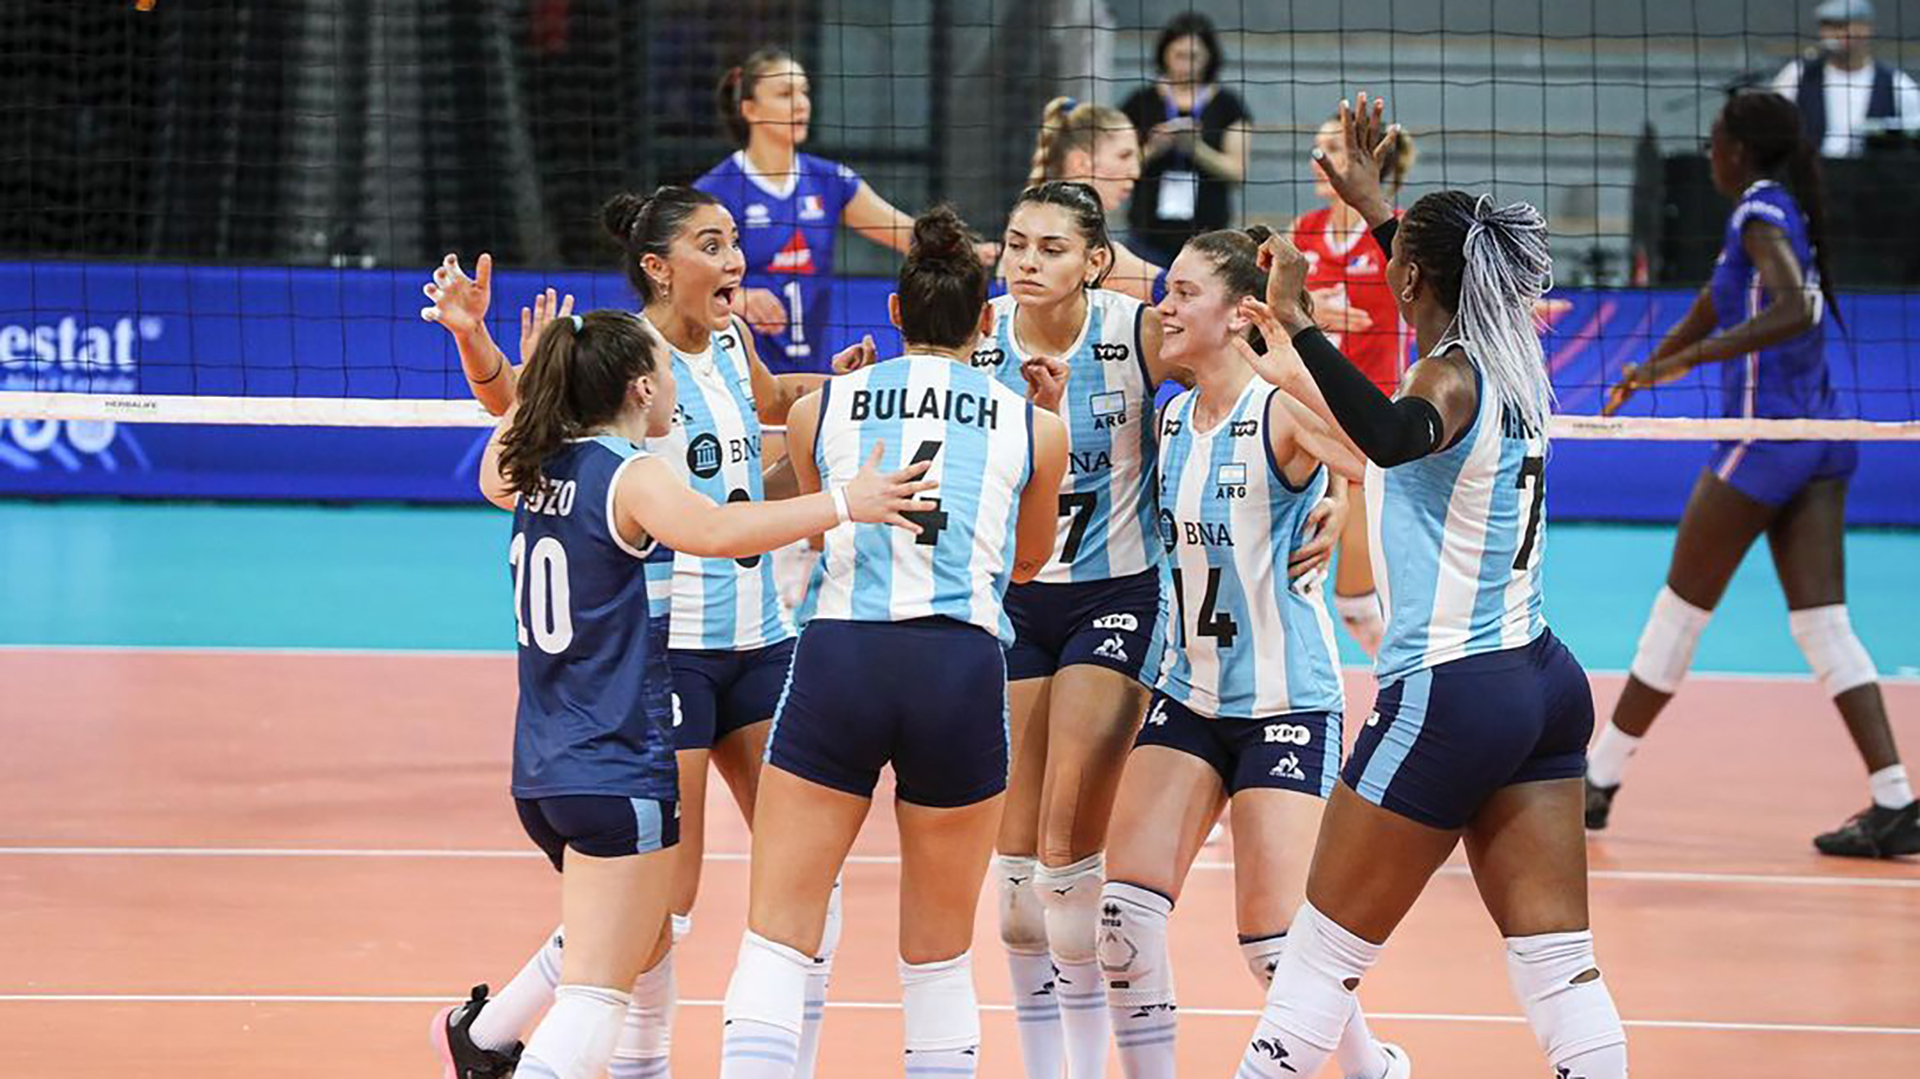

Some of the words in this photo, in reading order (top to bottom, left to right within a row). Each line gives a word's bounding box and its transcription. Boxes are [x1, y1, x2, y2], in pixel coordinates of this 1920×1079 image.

[850, 387, 998, 430] BULAICH
[1094, 414, 1127, 430] ARG
[729, 435, 761, 463] BN
[1068, 451, 1113, 475] NA
[885, 440, 949, 546] 4
[1216, 487, 1247, 499] ARG
[1512, 456, 1544, 570] 7
[1183, 521, 1235, 547] BNA
[1172, 567, 1238, 648] 14
